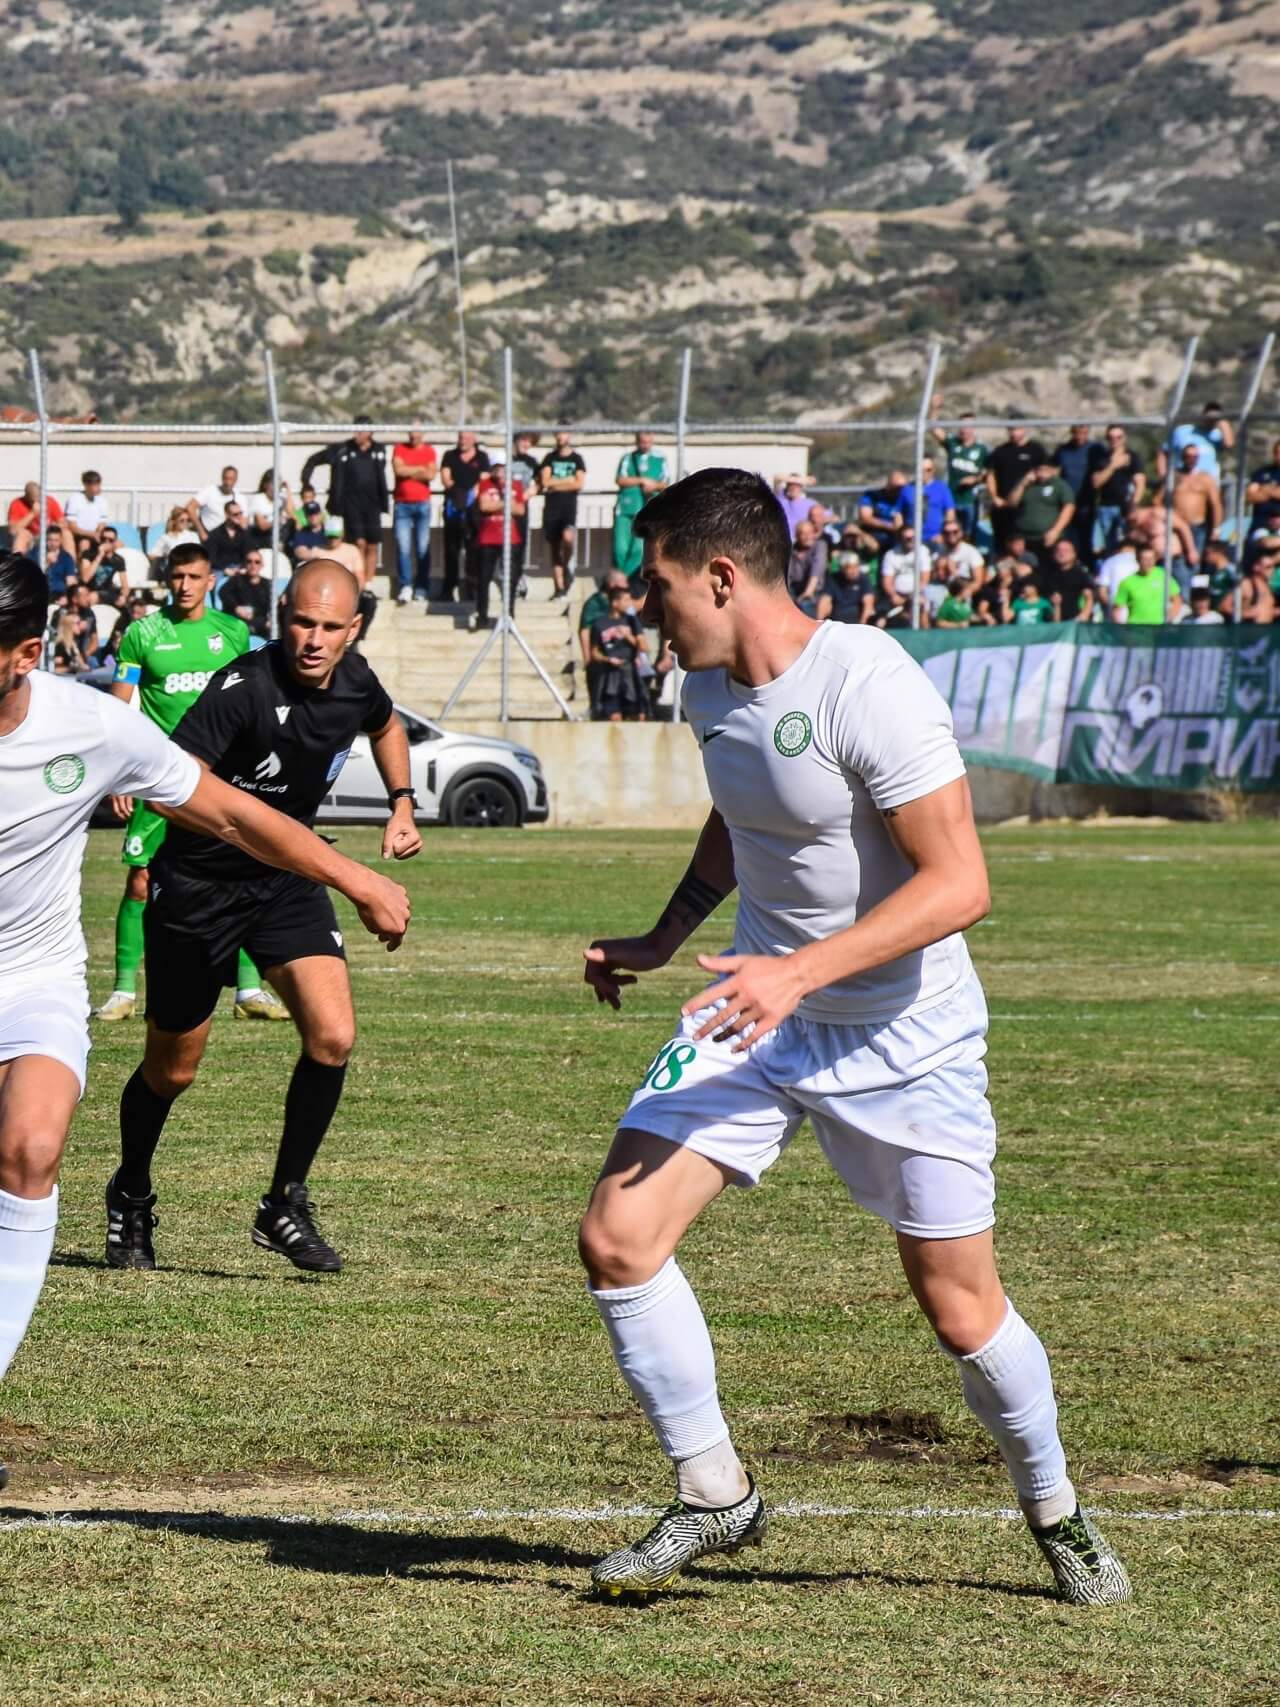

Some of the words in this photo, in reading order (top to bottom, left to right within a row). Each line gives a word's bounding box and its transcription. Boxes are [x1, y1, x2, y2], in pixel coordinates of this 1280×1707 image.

[164, 671, 216, 694] 888
[231, 775, 257, 790] Fuel
[258, 783, 289, 794] Card
